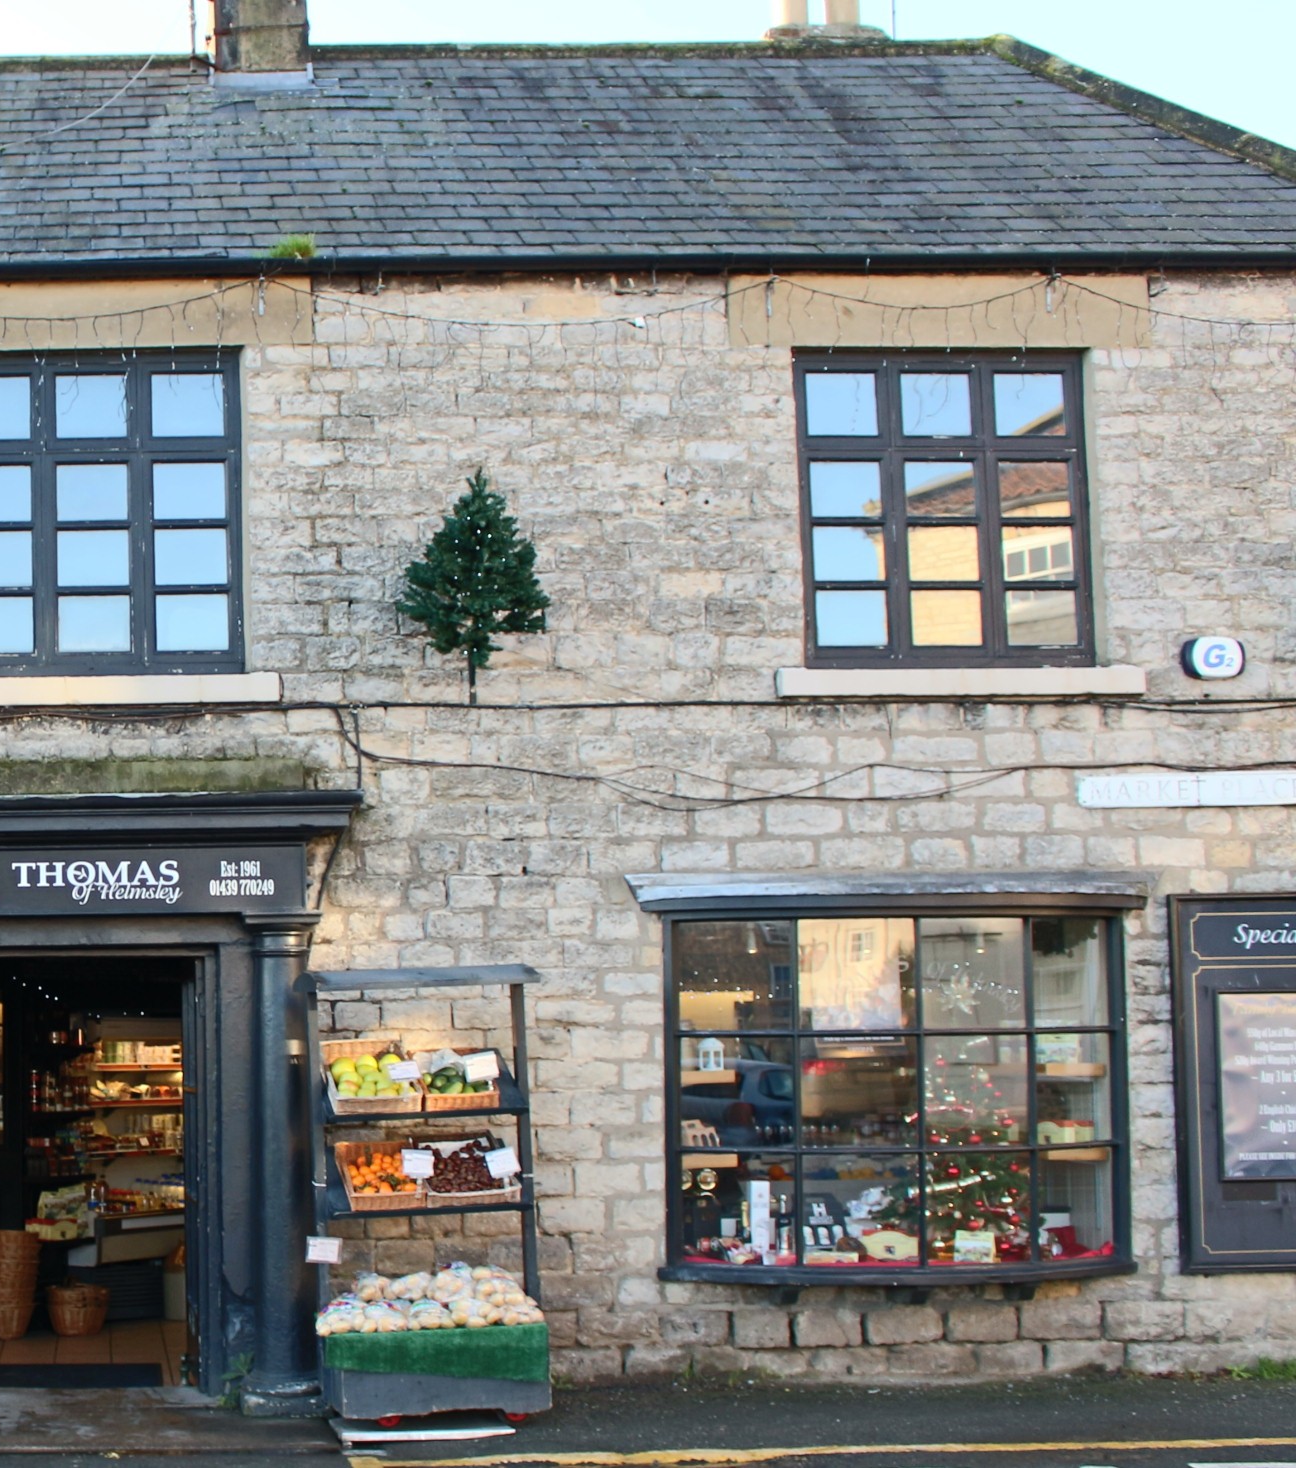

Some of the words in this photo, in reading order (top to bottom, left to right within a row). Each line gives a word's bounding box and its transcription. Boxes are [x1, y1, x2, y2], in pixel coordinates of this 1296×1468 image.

[1090, 779, 1206, 801] MARKET
[11, 859, 180, 888] THOMAS
[239, 860, 261, 877] 1961
[98, 880, 184, 904] Helmsley
[209, 879, 238, 896] 01439
[239, 879, 275, 896] 770249
